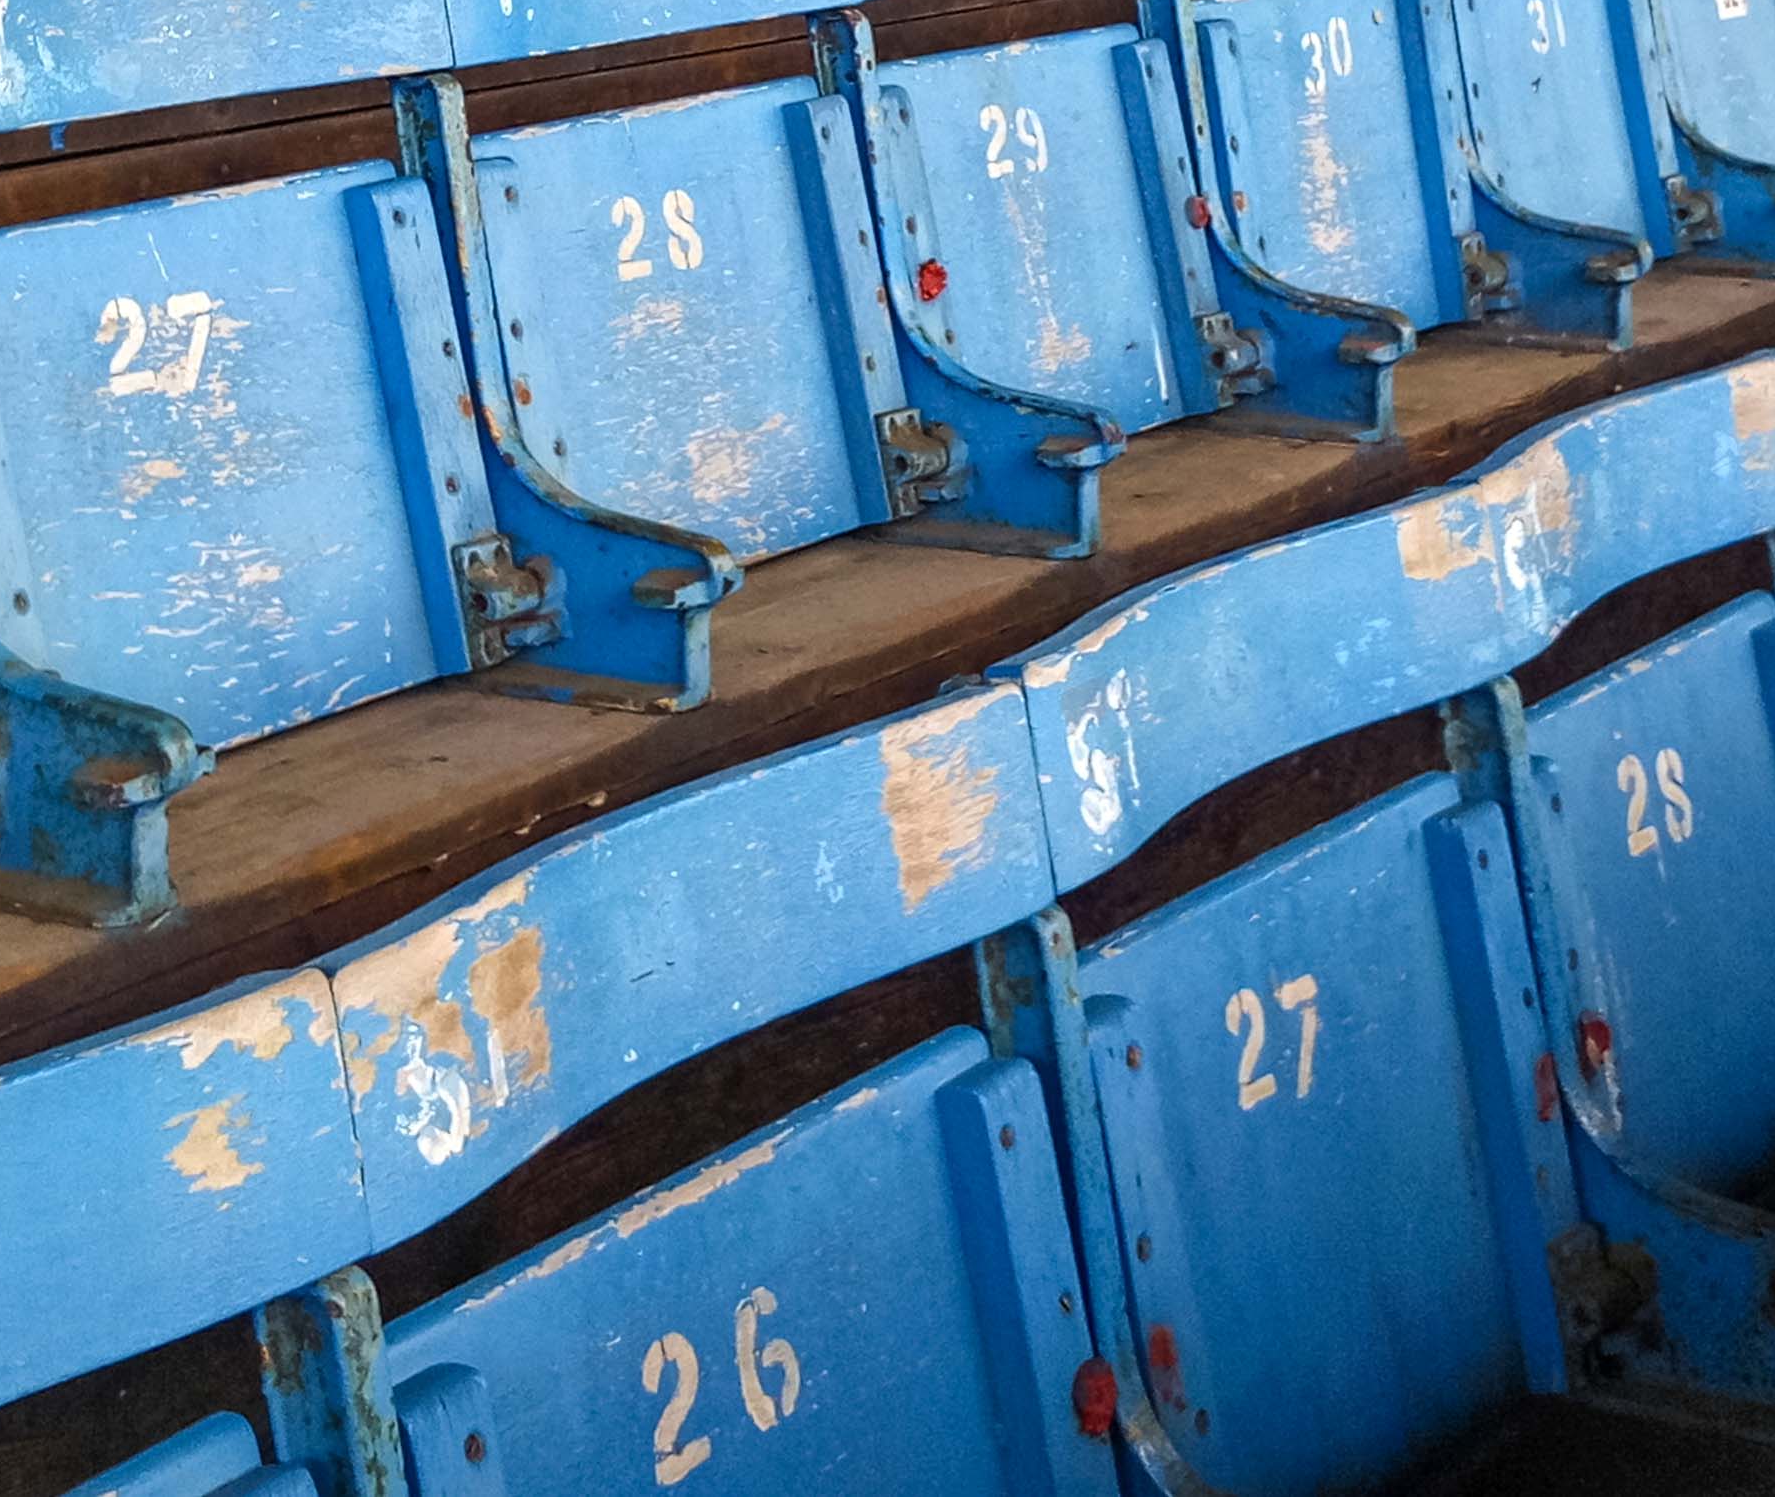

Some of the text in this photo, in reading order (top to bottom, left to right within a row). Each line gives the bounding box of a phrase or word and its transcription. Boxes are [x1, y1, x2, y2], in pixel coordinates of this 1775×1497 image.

[1302, 17, 1352, 102] 30
[980, 105, 1047, 178] 29
[611, 190, 702, 281] 28
[95, 294, 215, 397] 27
[1617, 748, 1692, 856] 28
[1226, 974, 1321, 1110] 27
[642, 1287, 800, 1485] 26
